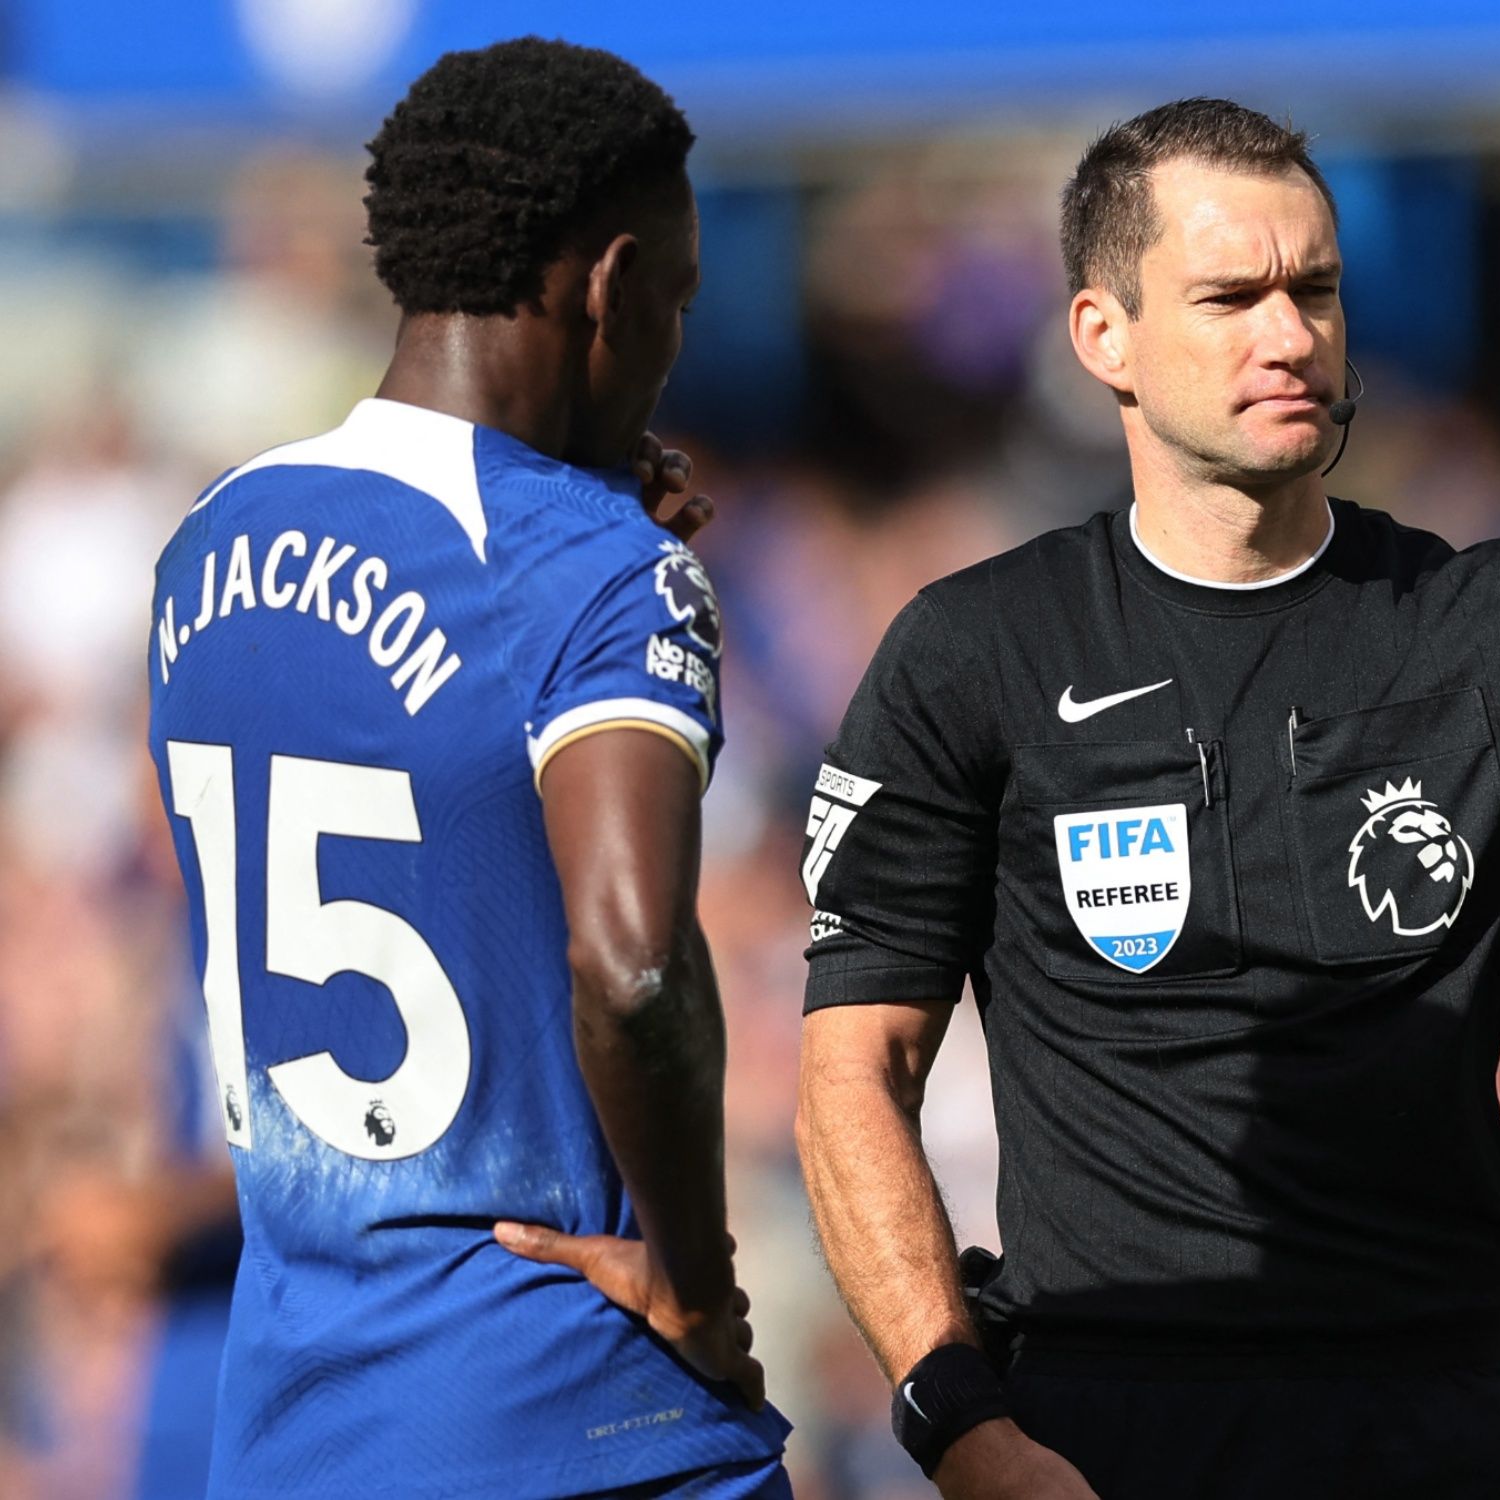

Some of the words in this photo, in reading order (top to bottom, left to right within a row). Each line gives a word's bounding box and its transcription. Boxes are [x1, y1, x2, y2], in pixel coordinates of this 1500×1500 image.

[158, 529, 462, 717] N.JACKSON
[818, 768, 856, 797] SPORTS
[1068, 818, 1175, 862] FIFA
[1076, 882, 1180, 908] REFEREE
[166, 738, 472, 1161] 15
[1111, 937, 1159, 957] 2023
